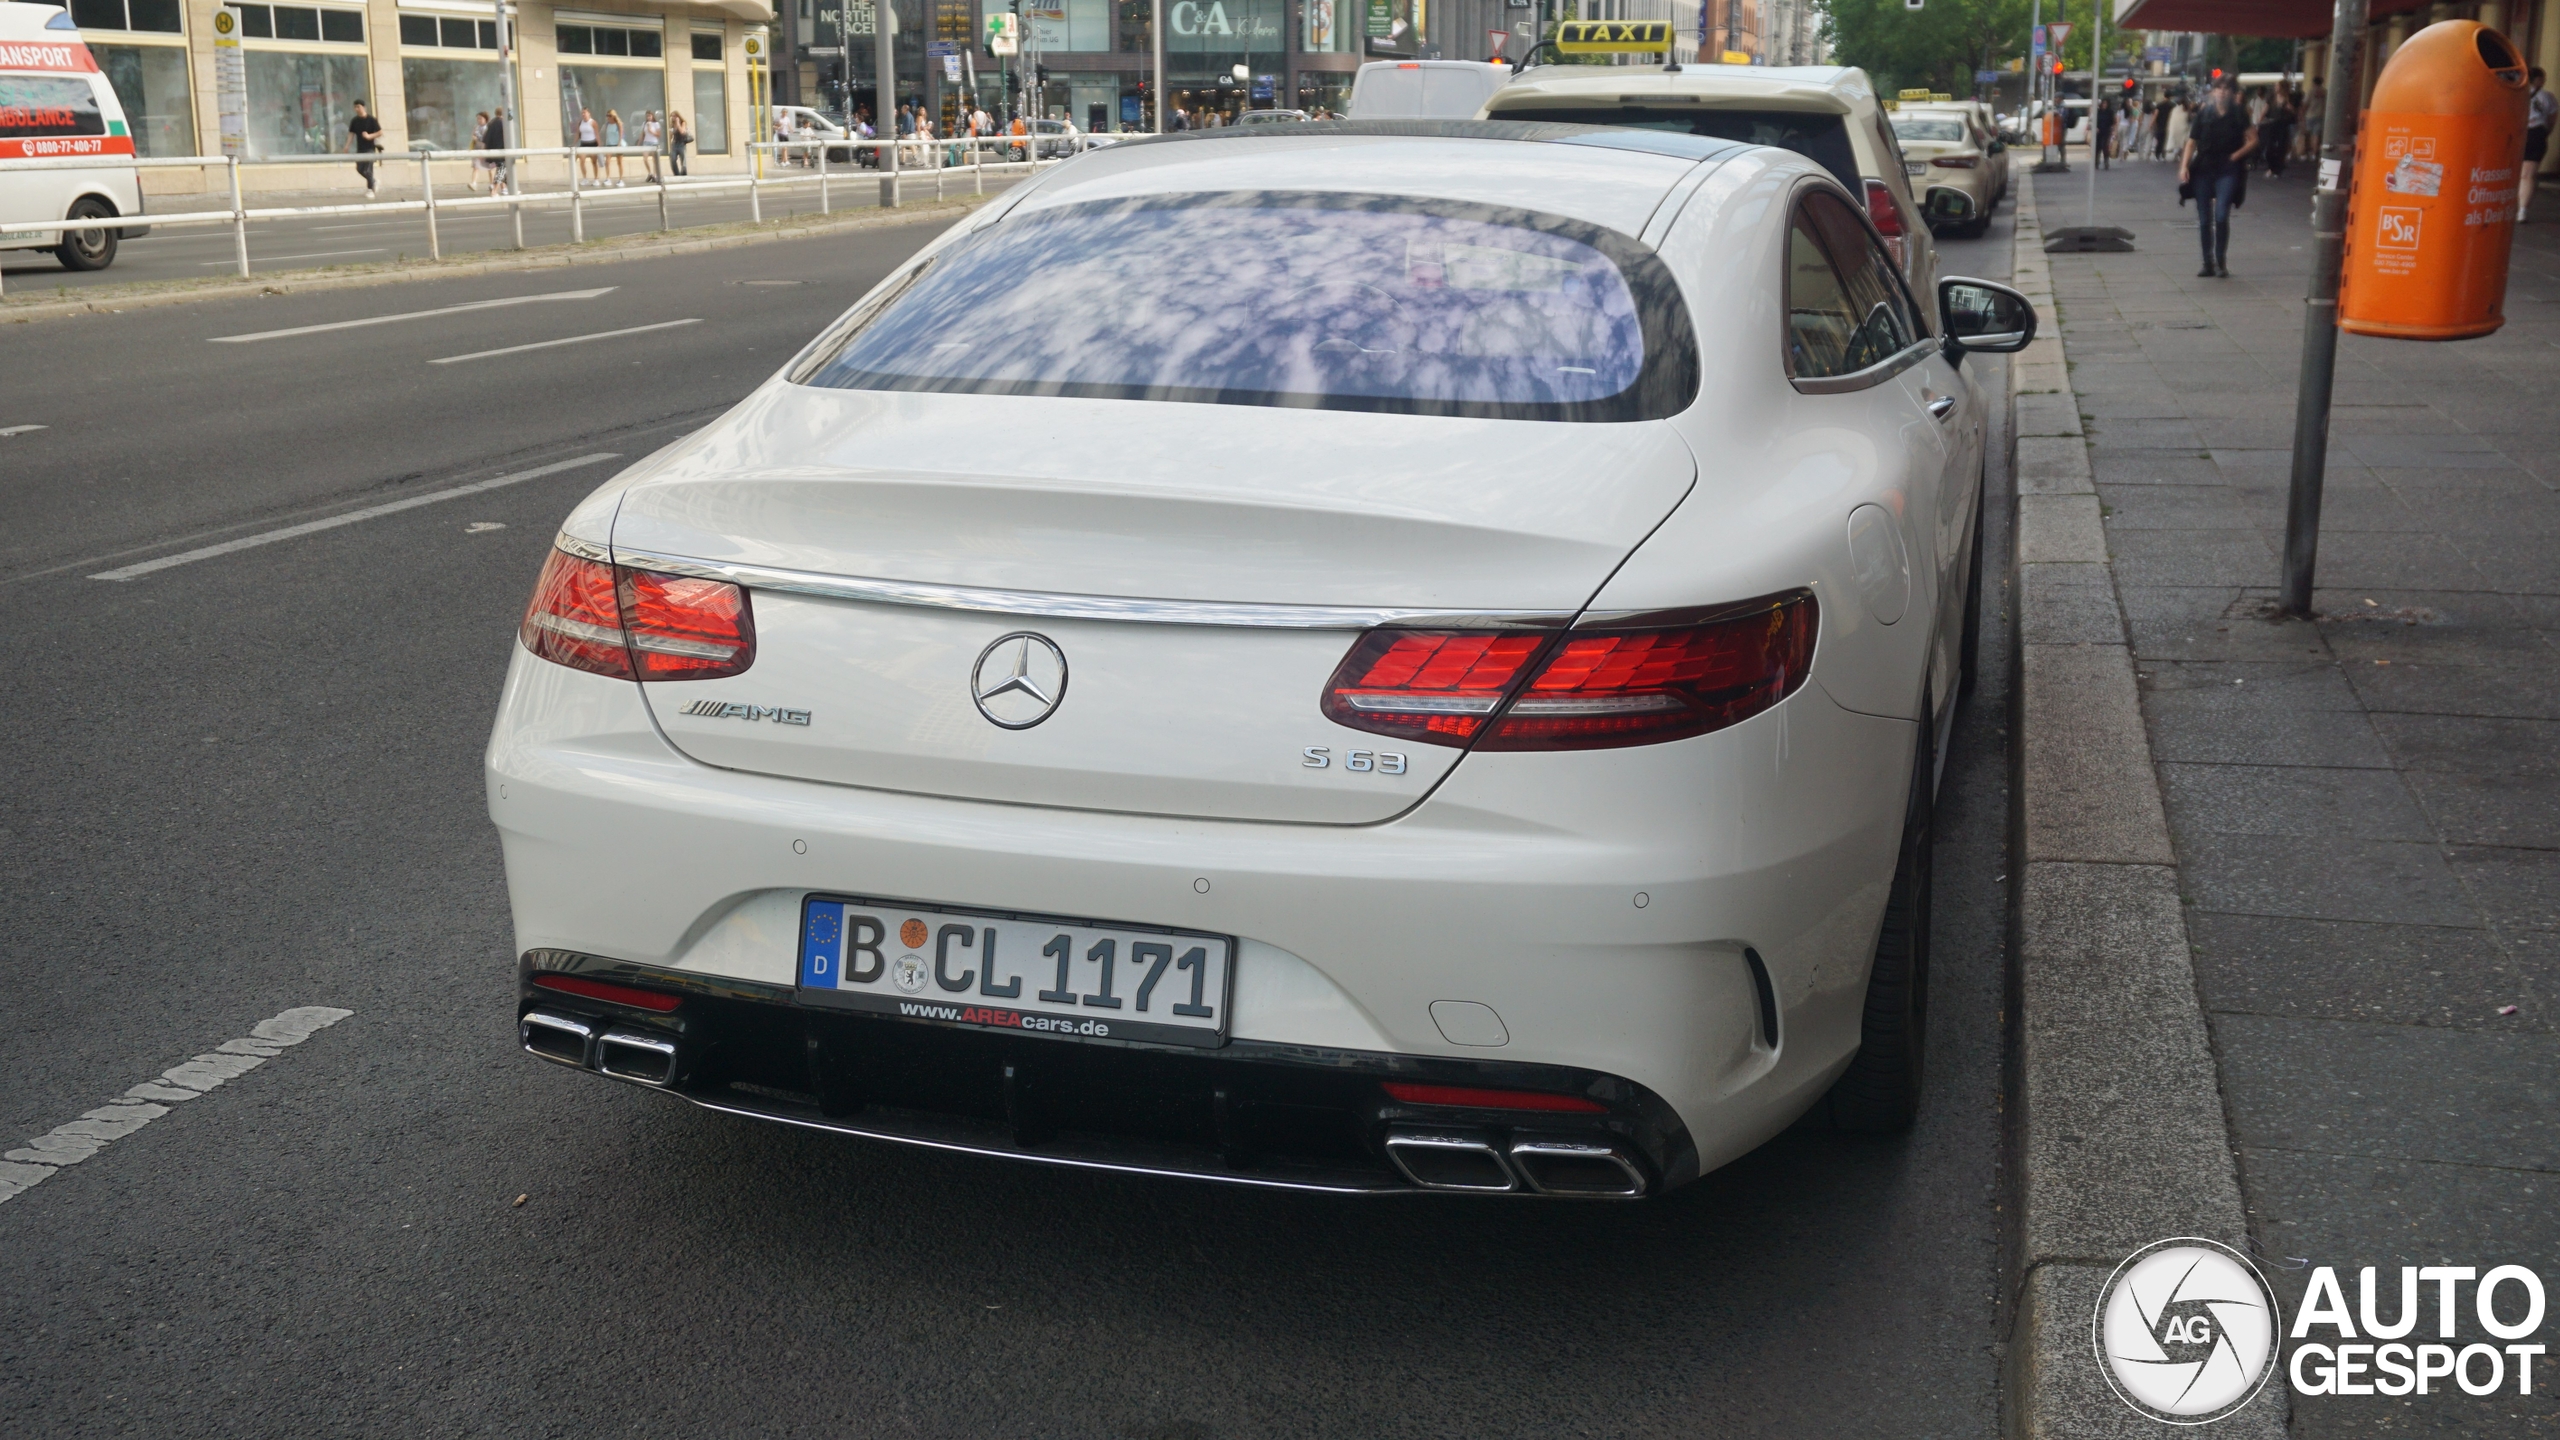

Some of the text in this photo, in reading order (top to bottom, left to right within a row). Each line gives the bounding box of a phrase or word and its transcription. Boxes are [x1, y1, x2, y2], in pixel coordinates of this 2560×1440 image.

[1171, 0, 1233, 35] C&A
[1576, 24, 1653, 41] TAXI
[0, 46, 73, 67] ANSPORT
[36, 140, 102, 154] 0800-77-400-77
[2383, 214, 2416, 242] BSR
[2464, 209, 2482, 226] als
[718, 702, 812, 727] AMG
[1302, 745, 1408, 776] S 63
[814, 955, 828, 974] D
[844, 914, 1213, 1019] B CL 1171
[899, 1002, 1109, 1037] www.AREAcars.de
